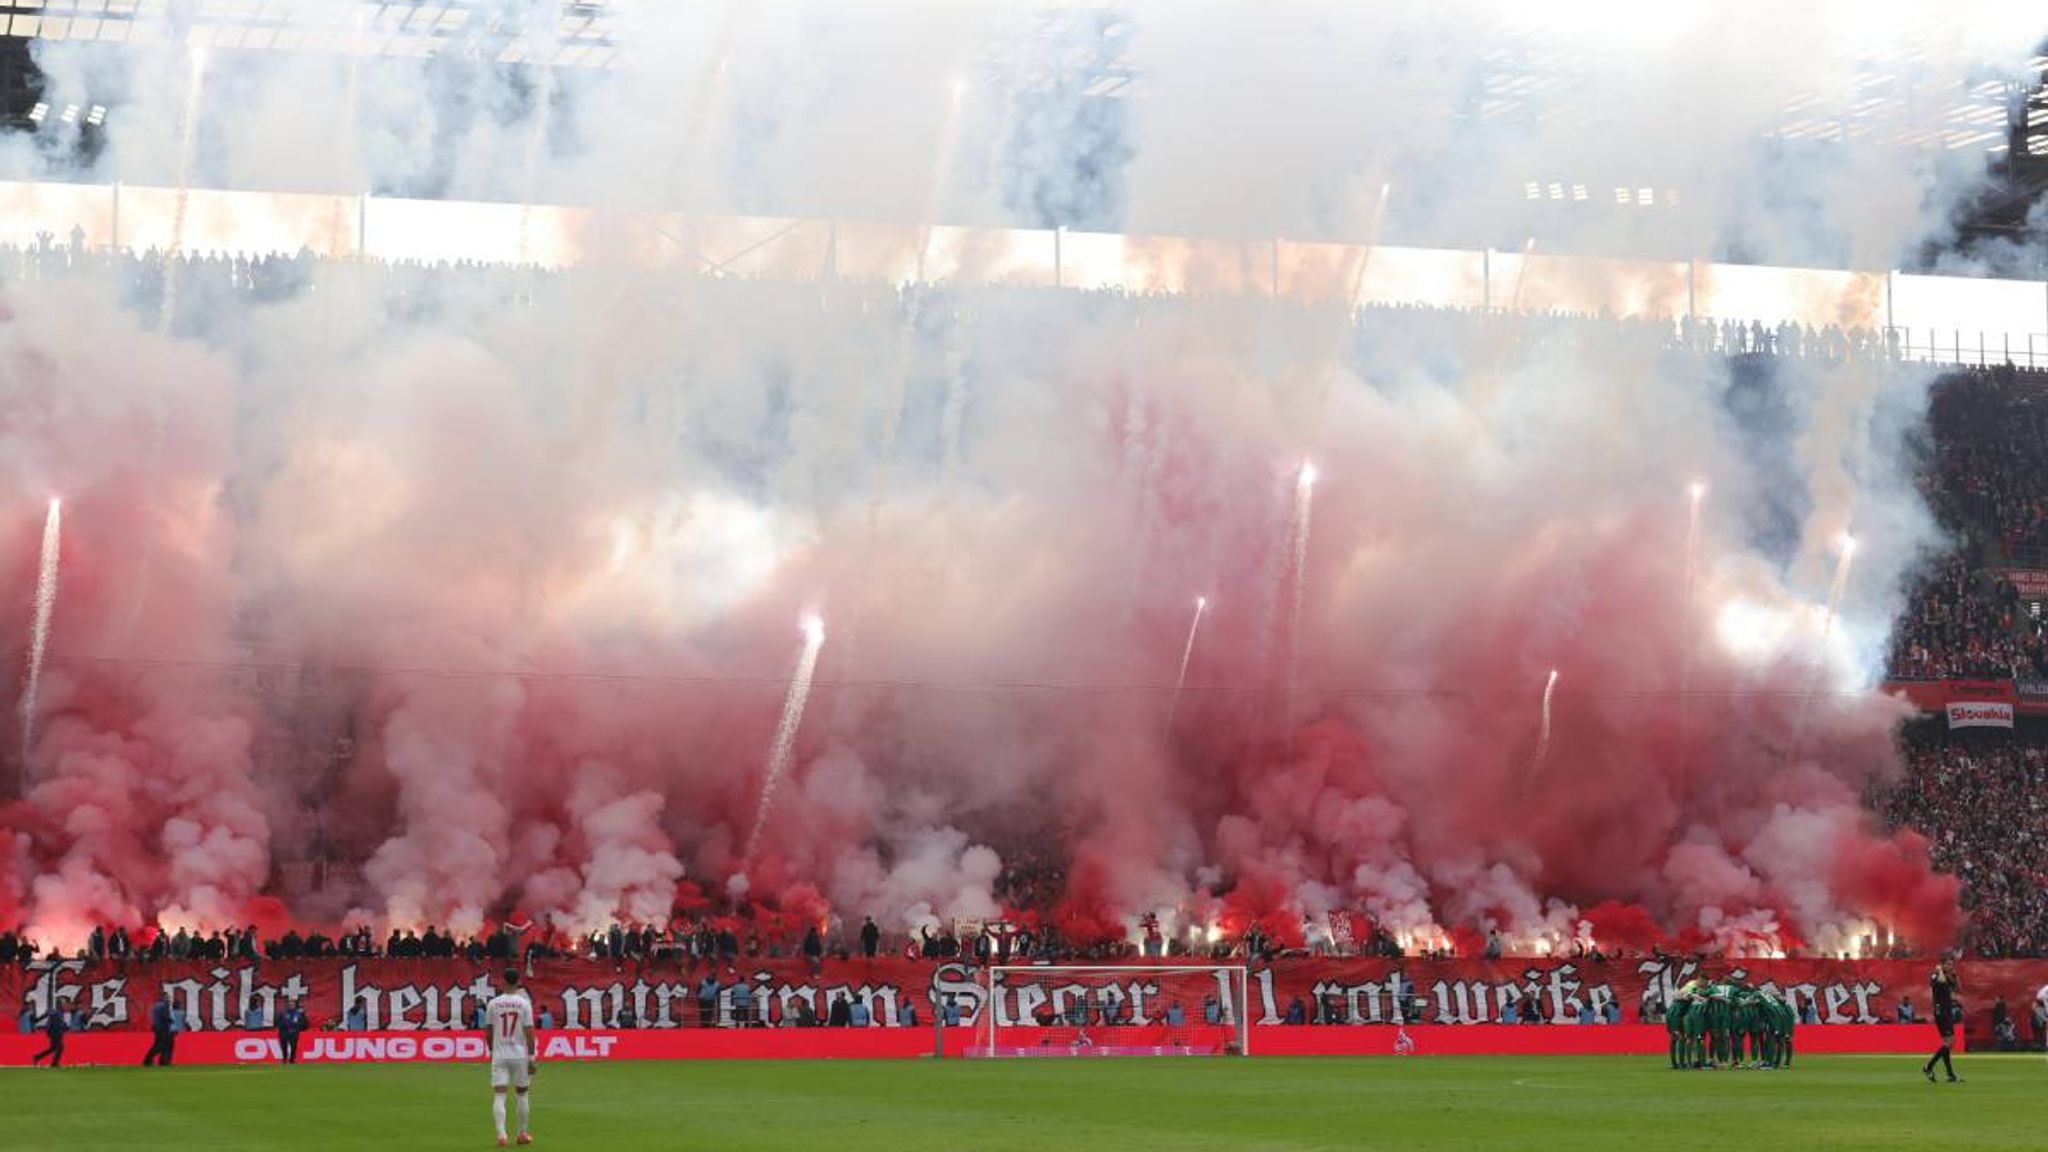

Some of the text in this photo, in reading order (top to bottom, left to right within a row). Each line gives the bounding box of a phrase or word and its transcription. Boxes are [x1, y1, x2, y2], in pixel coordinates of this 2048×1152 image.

[25, 959, 129, 1028] Es
[561, 977, 689, 1029] nur
[499, 1011, 519, 1038] 17
[302, 1037, 417, 1059] JUNG
[422, 1036, 539, 1058] OD
[543, 1036, 618, 1058] ALT
